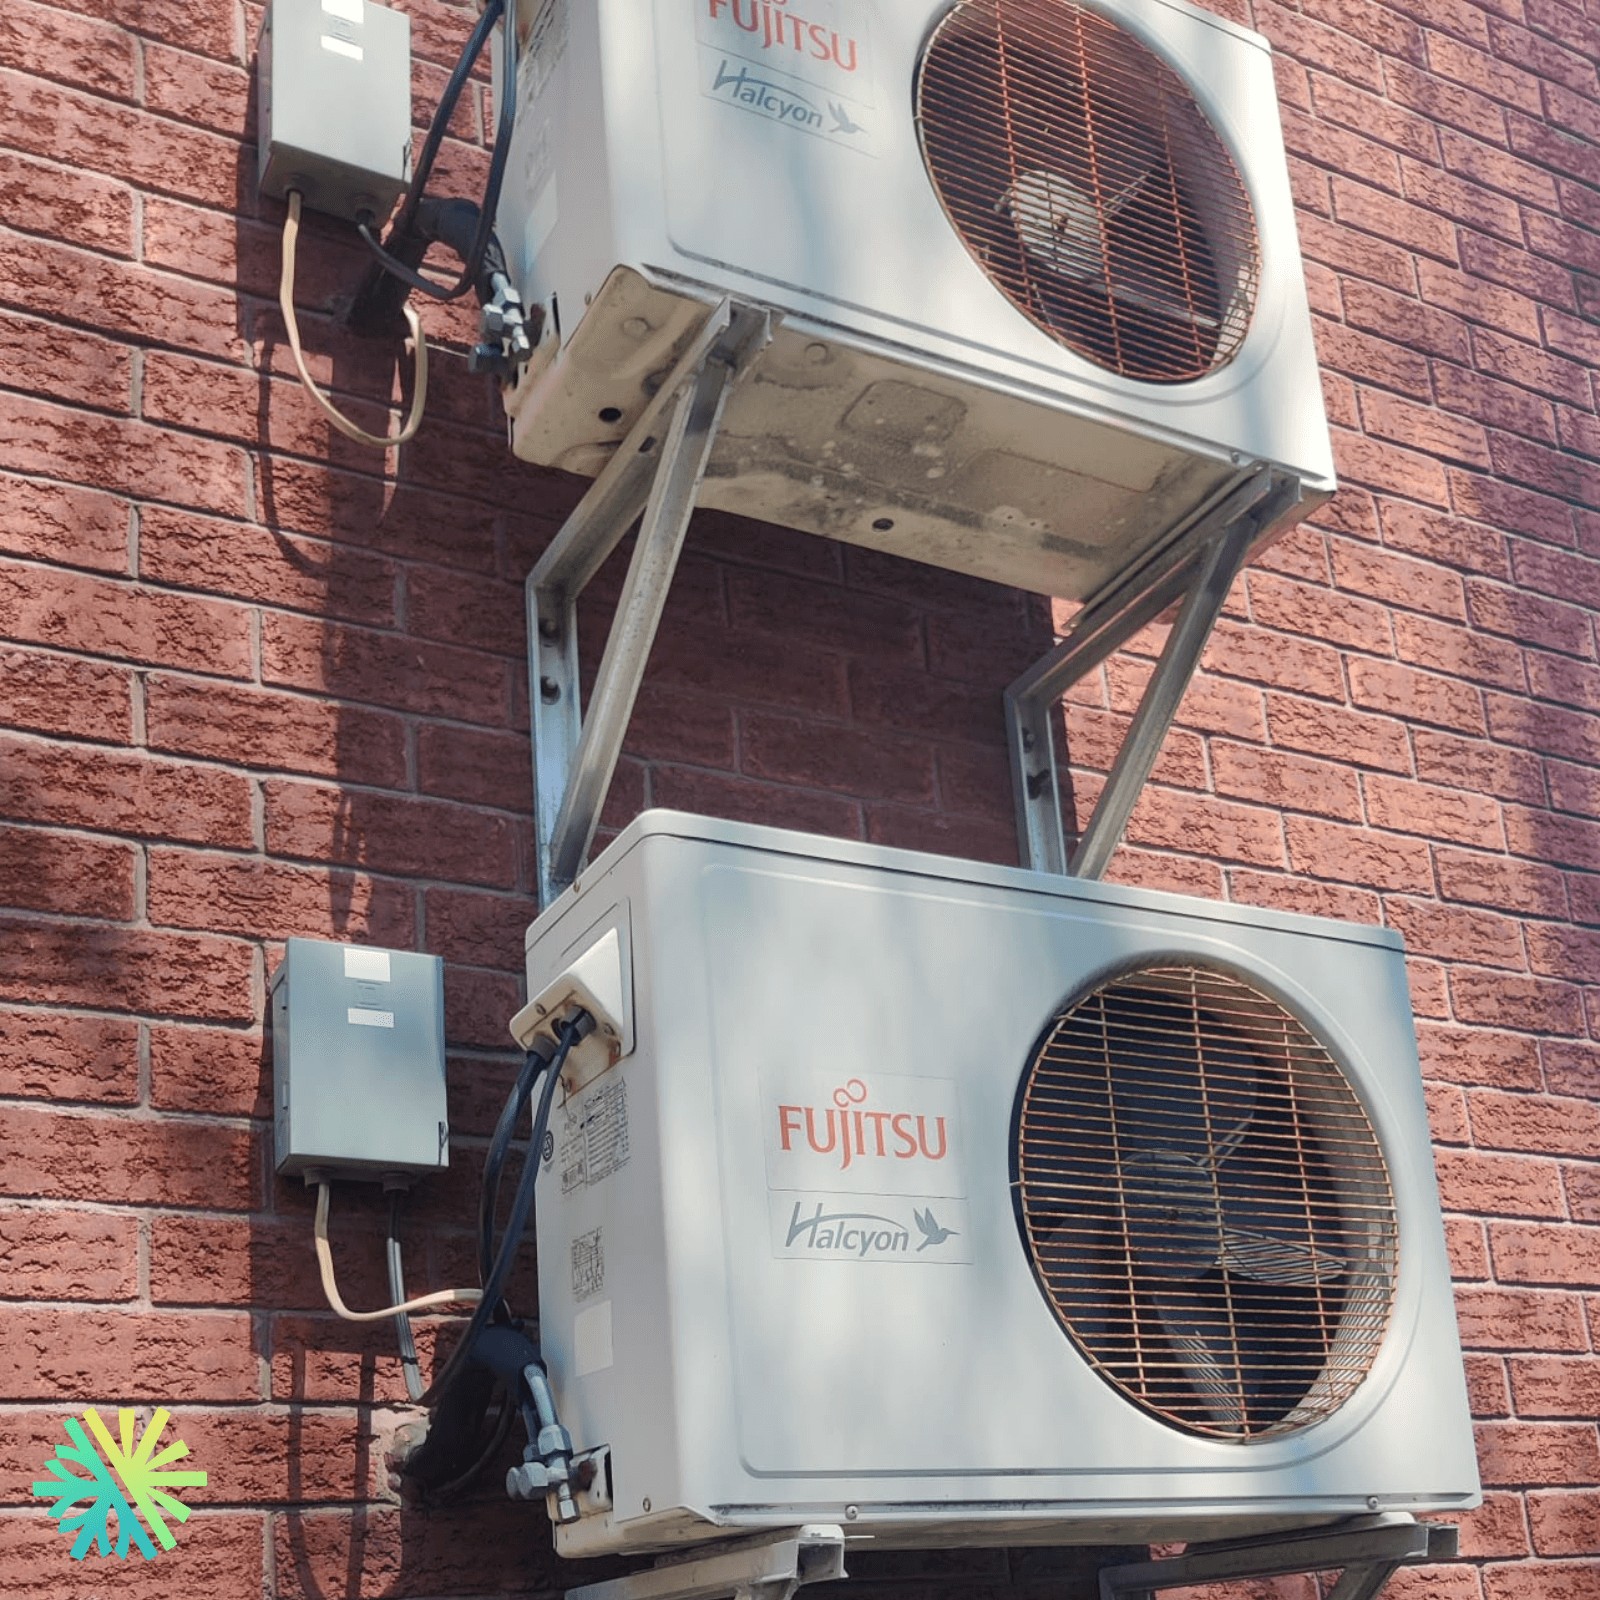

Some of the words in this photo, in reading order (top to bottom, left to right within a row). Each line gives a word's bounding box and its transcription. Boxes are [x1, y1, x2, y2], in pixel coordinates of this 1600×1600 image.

[712, 59, 823, 128] Halcyon
[778, 1105, 948, 1170] FUJITSU
[785, 1201, 909, 1257] Halcyon
